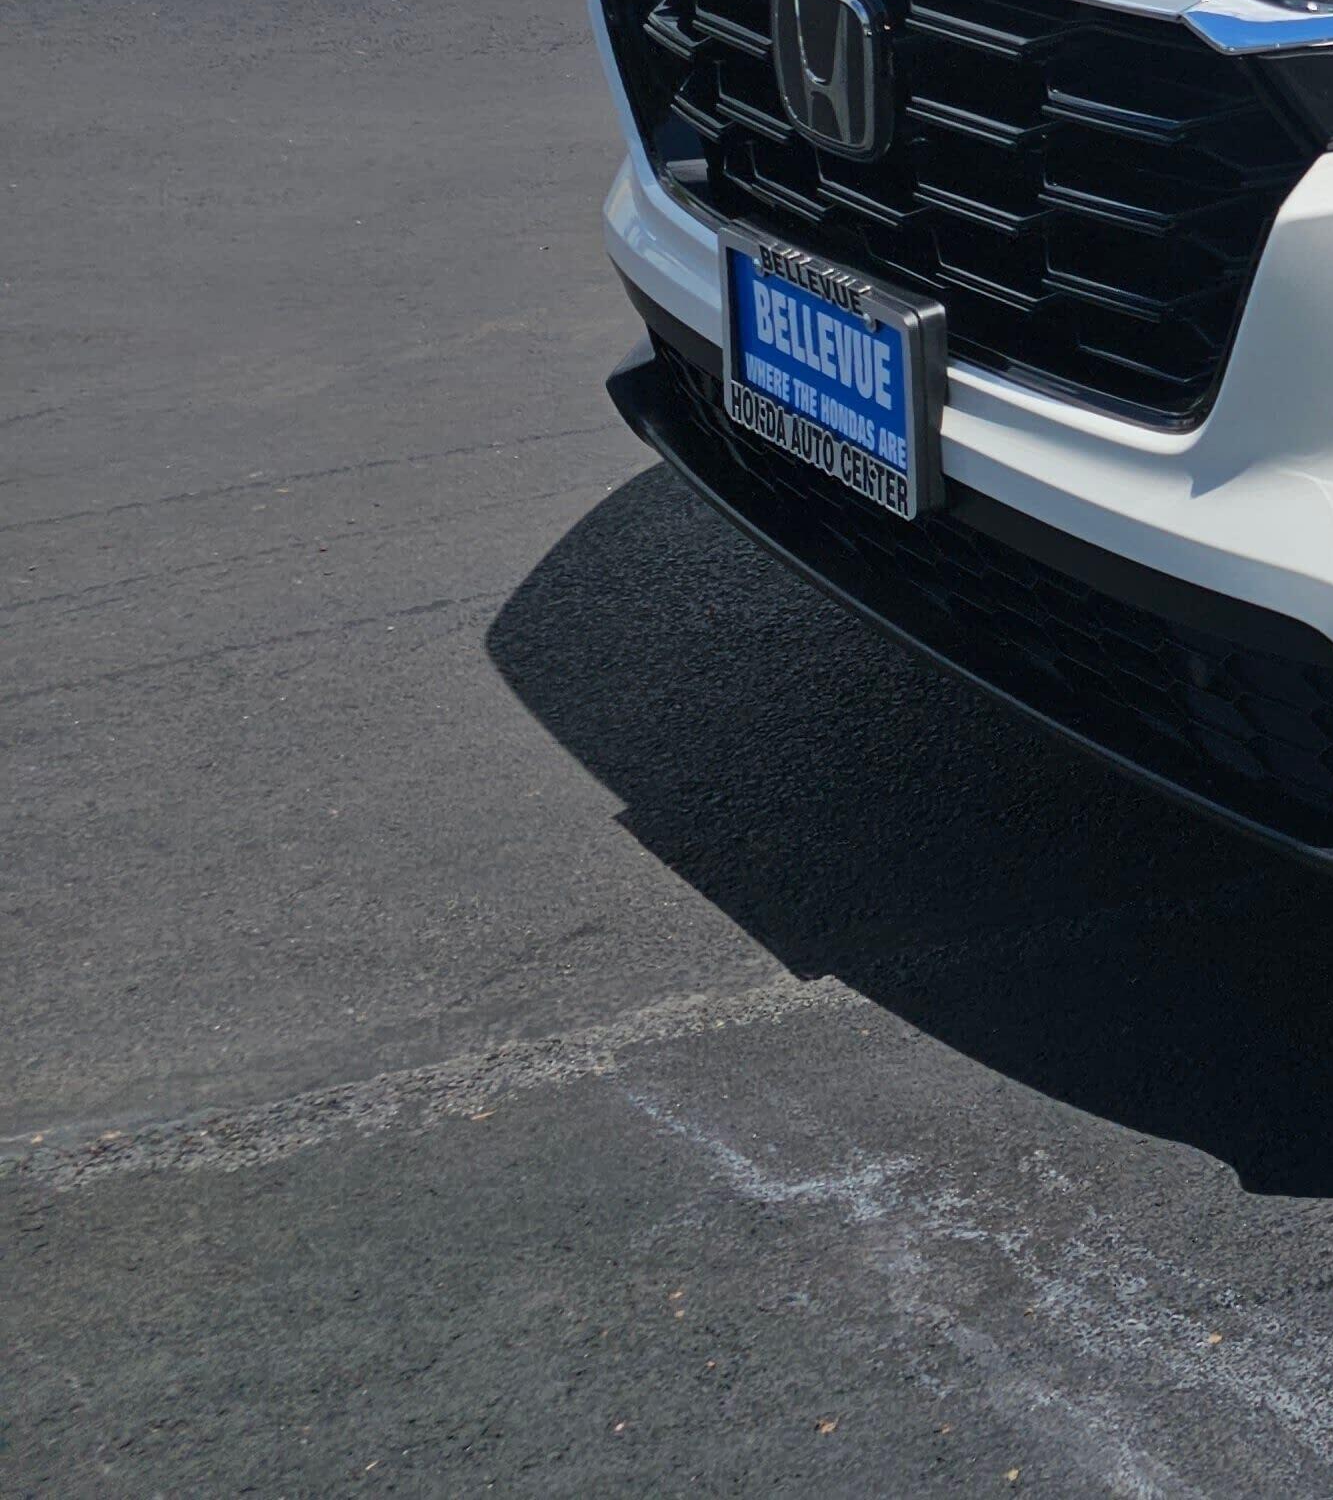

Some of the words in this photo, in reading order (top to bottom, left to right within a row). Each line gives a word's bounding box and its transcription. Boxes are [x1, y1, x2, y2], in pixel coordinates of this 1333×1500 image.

[758, 246, 865, 316] BELLEVUE
[753, 280, 893, 411] BELLEVUE
[731, 382, 786, 448] HONDA
[791, 415, 835, 477] AUTO
[840, 443, 909, 518] CENTER
[745, 352, 791, 401] WHERE
[793, 379, 818, 416] THE
[820, 391, 877, 451] HONDAS
[878, 428, 908, 470] ARE
